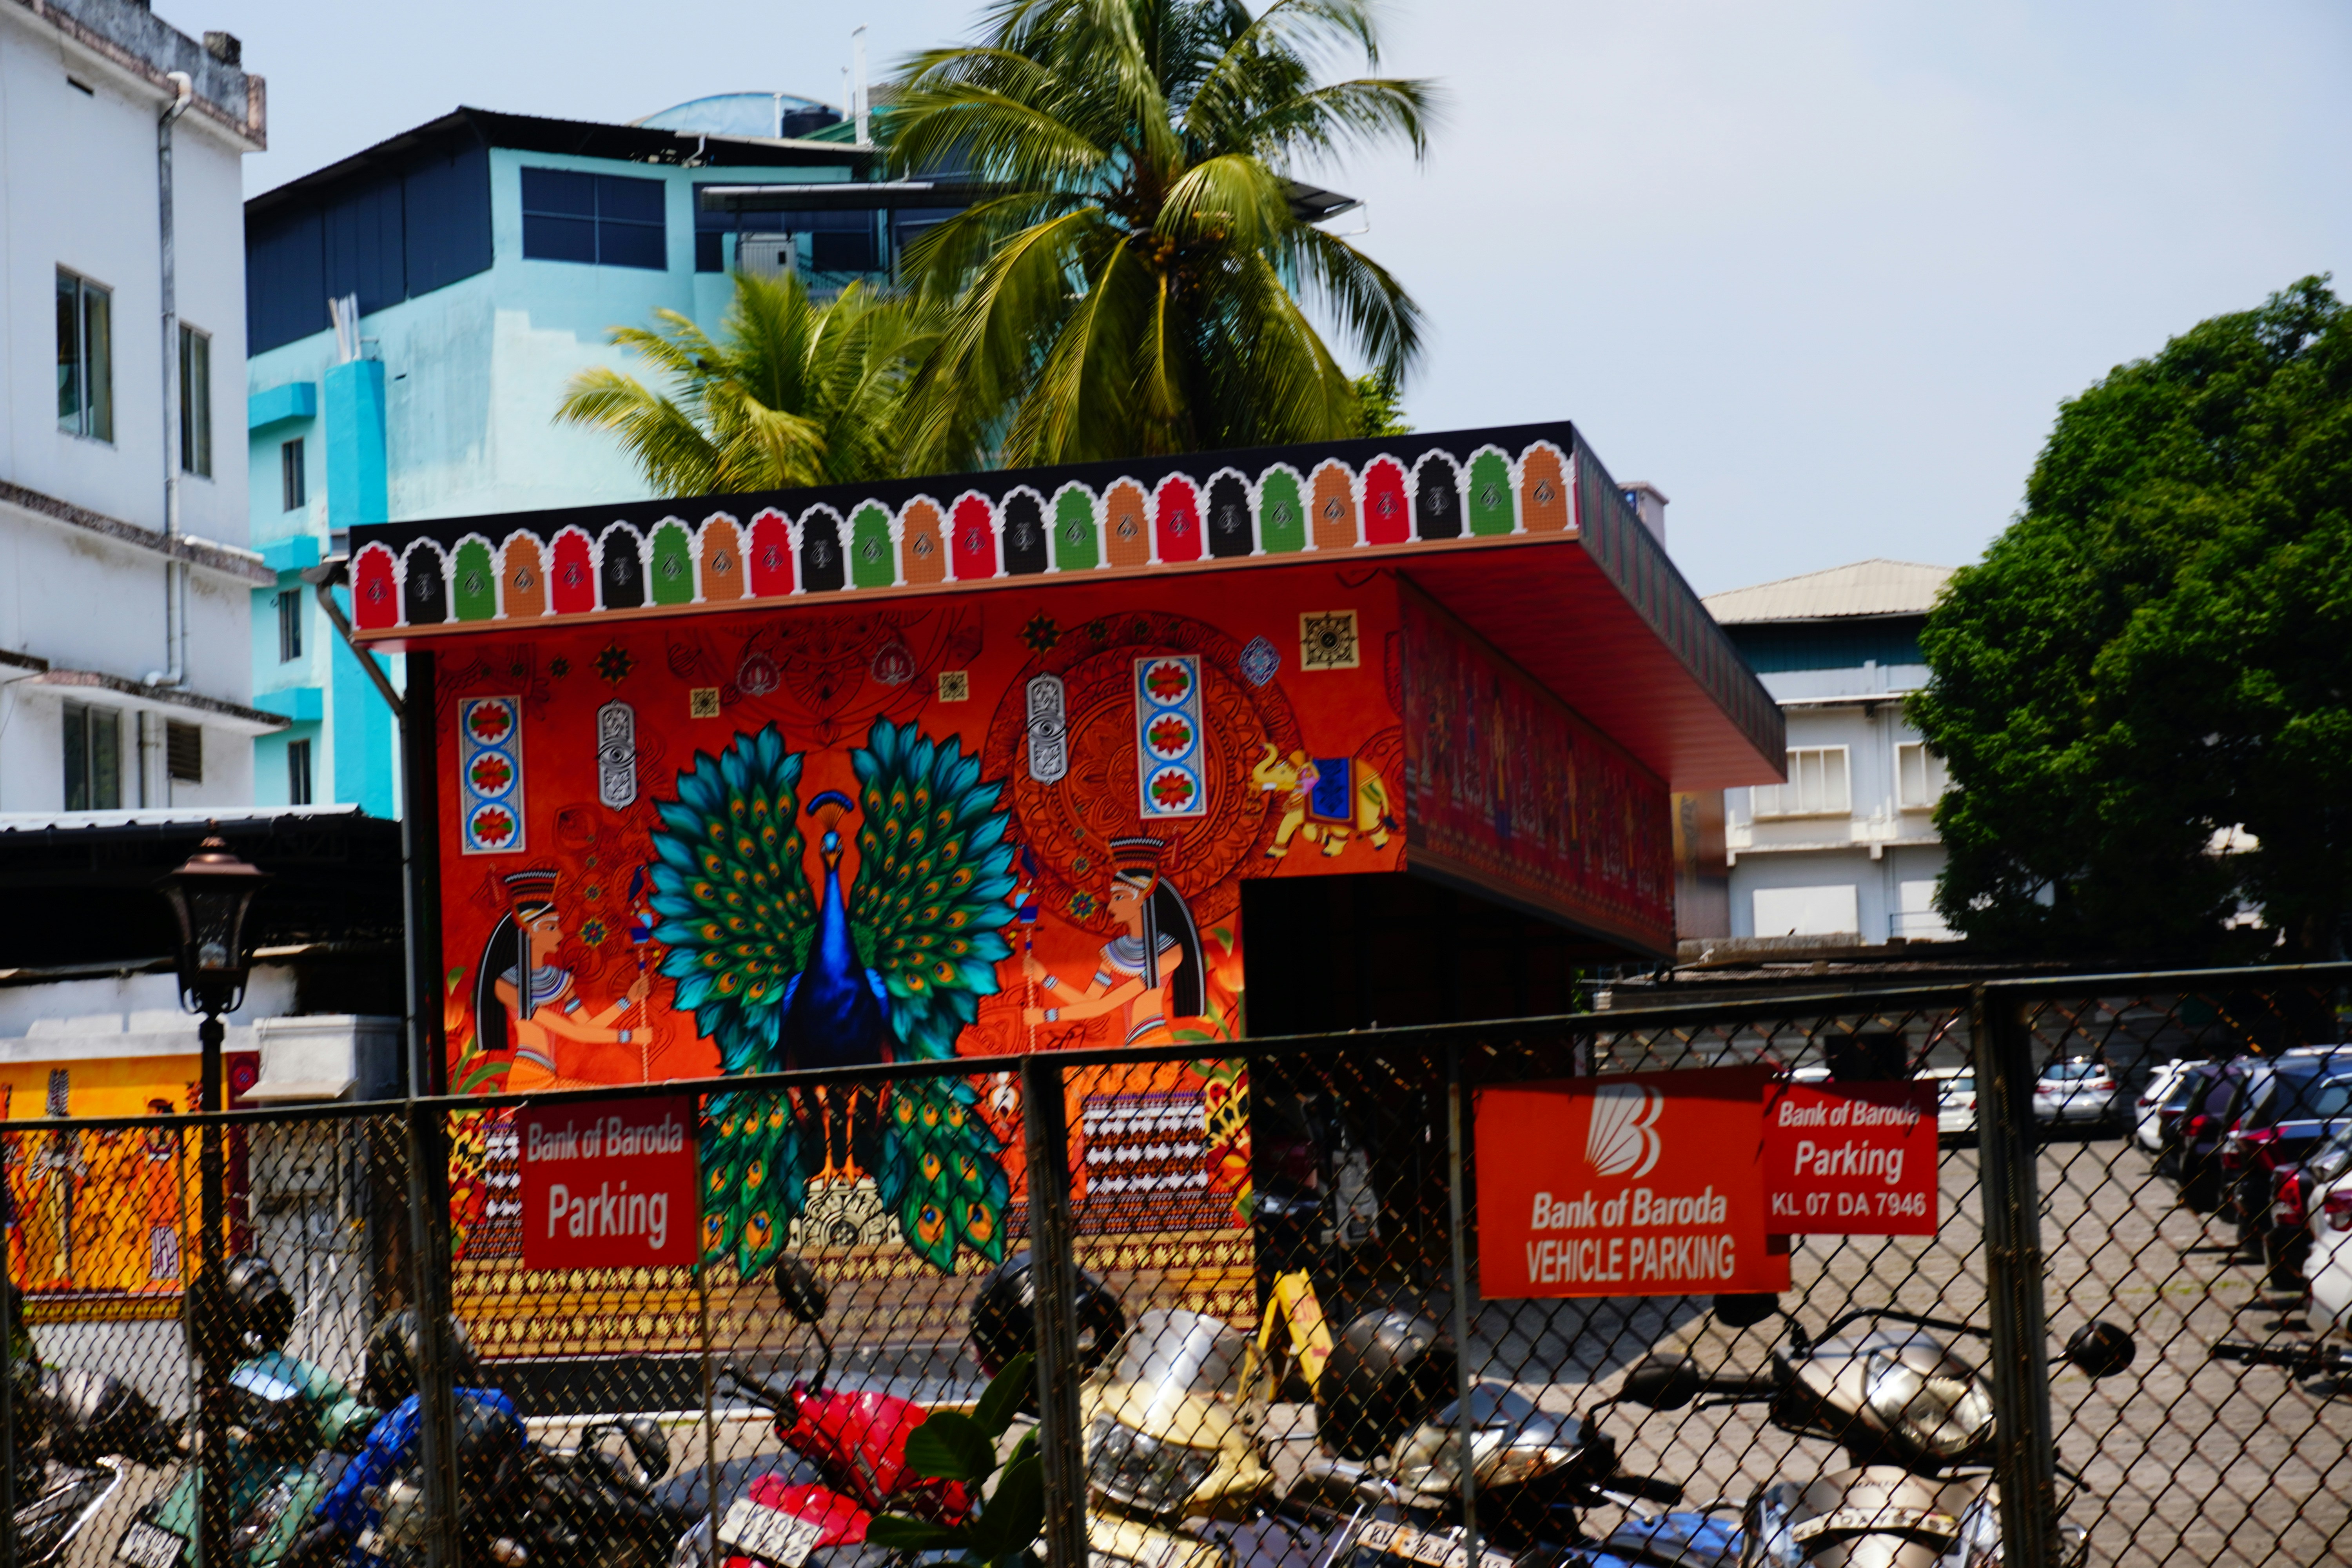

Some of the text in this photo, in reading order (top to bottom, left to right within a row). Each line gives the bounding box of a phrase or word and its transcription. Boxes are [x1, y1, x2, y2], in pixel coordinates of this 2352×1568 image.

[1778, 1098, 1921, 1127] Bank of Baroda
[527, 1111, 683, 1162] Bank of Baroda
[1794, 1139, 1905, 1185] Parking
[547, 1180, 668, 1250] Parking
[1531, 1185, 1727, 1230] Bank of Baroda
[1772, 1192, 1927, 1217] KL 07 DA 7946
[1526, 1234, 1735, 1283] VEHICLE PARKING
